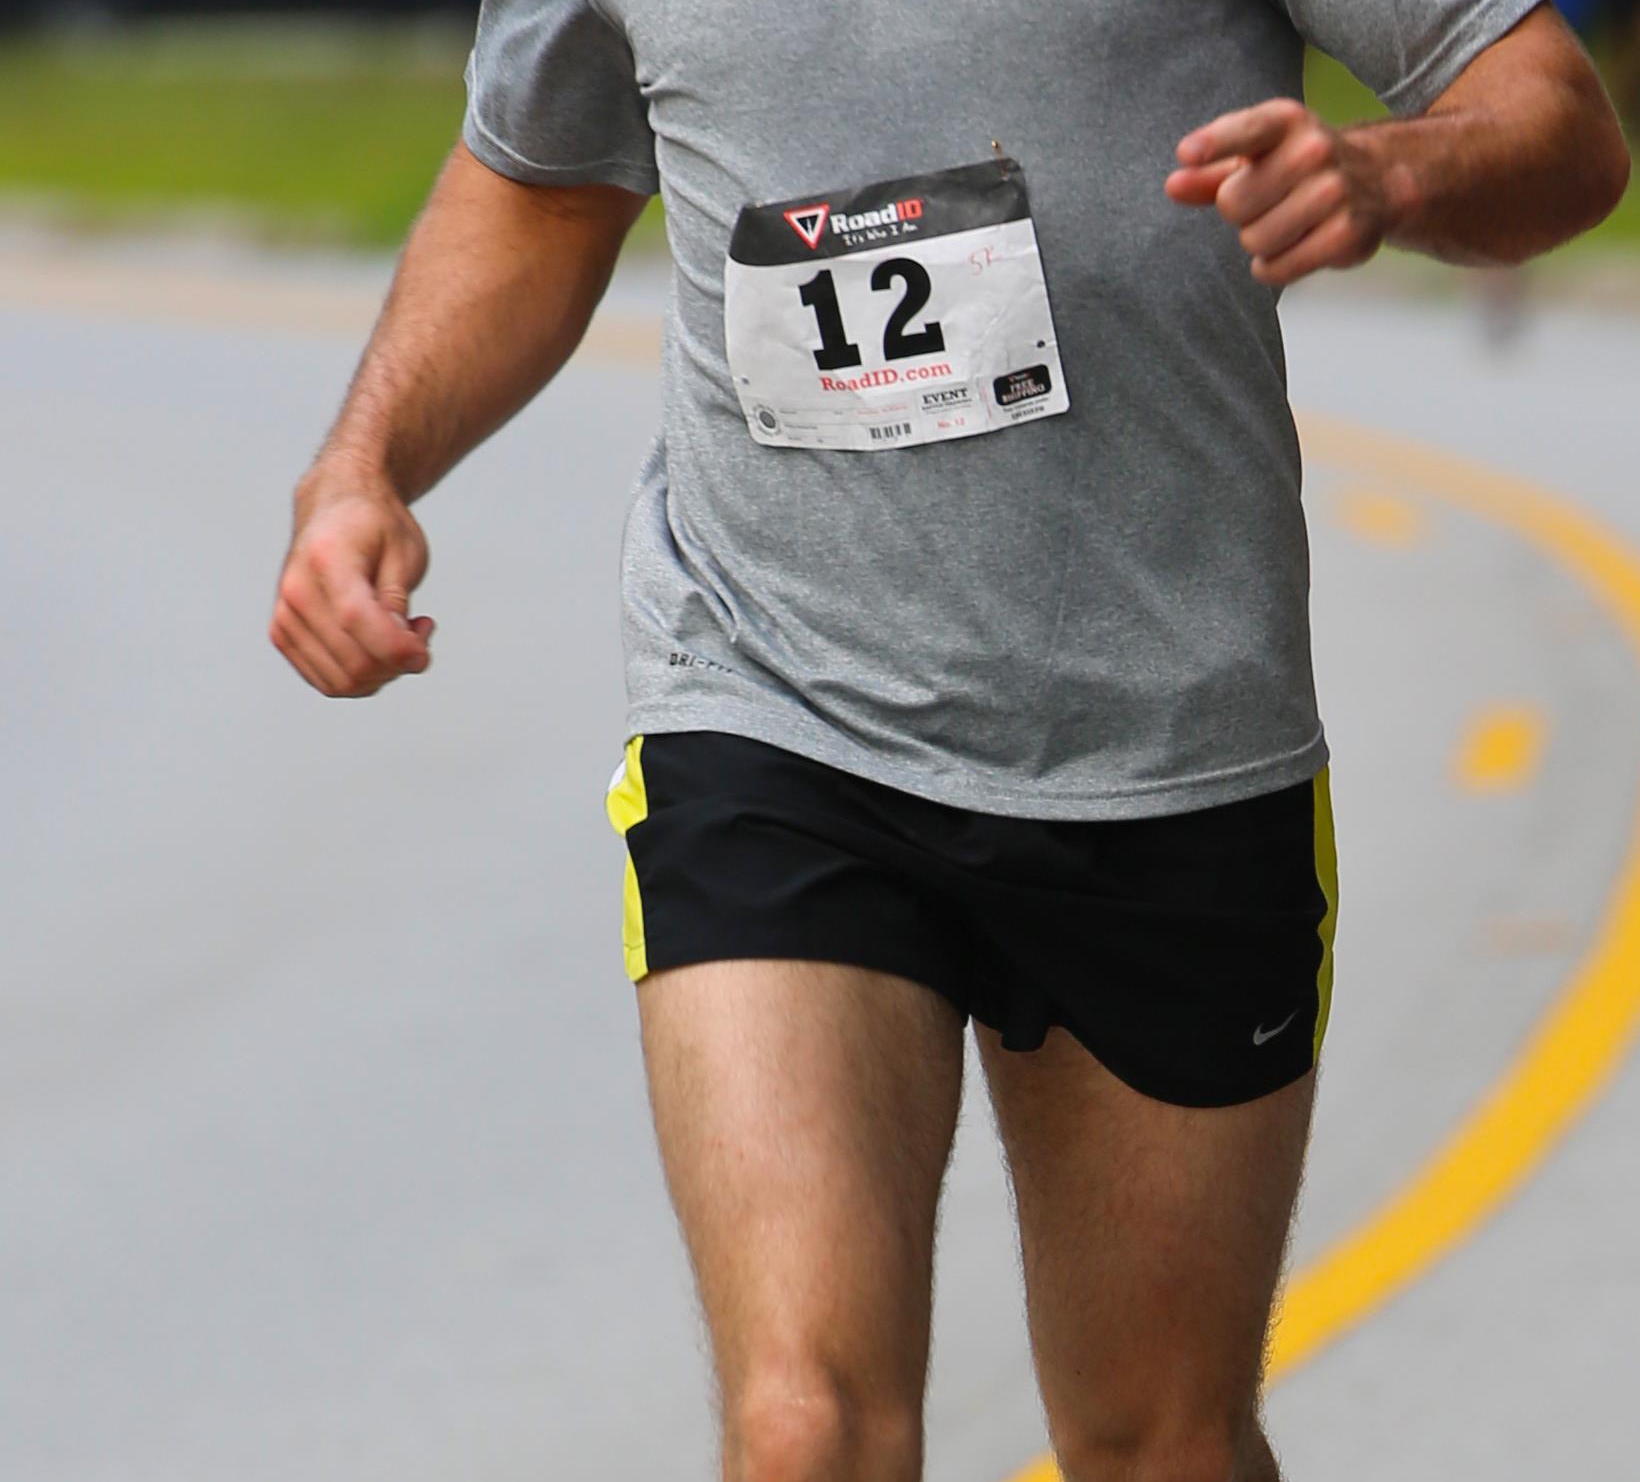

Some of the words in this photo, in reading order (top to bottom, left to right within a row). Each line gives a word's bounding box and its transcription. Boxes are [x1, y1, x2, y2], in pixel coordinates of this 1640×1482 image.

[830, 198, 923, 235] RoadID
[798, 257, 946, 371] 12
[821, 362, 953, 392] RoadID.com
[922, 388, 969, 405] EVENT
